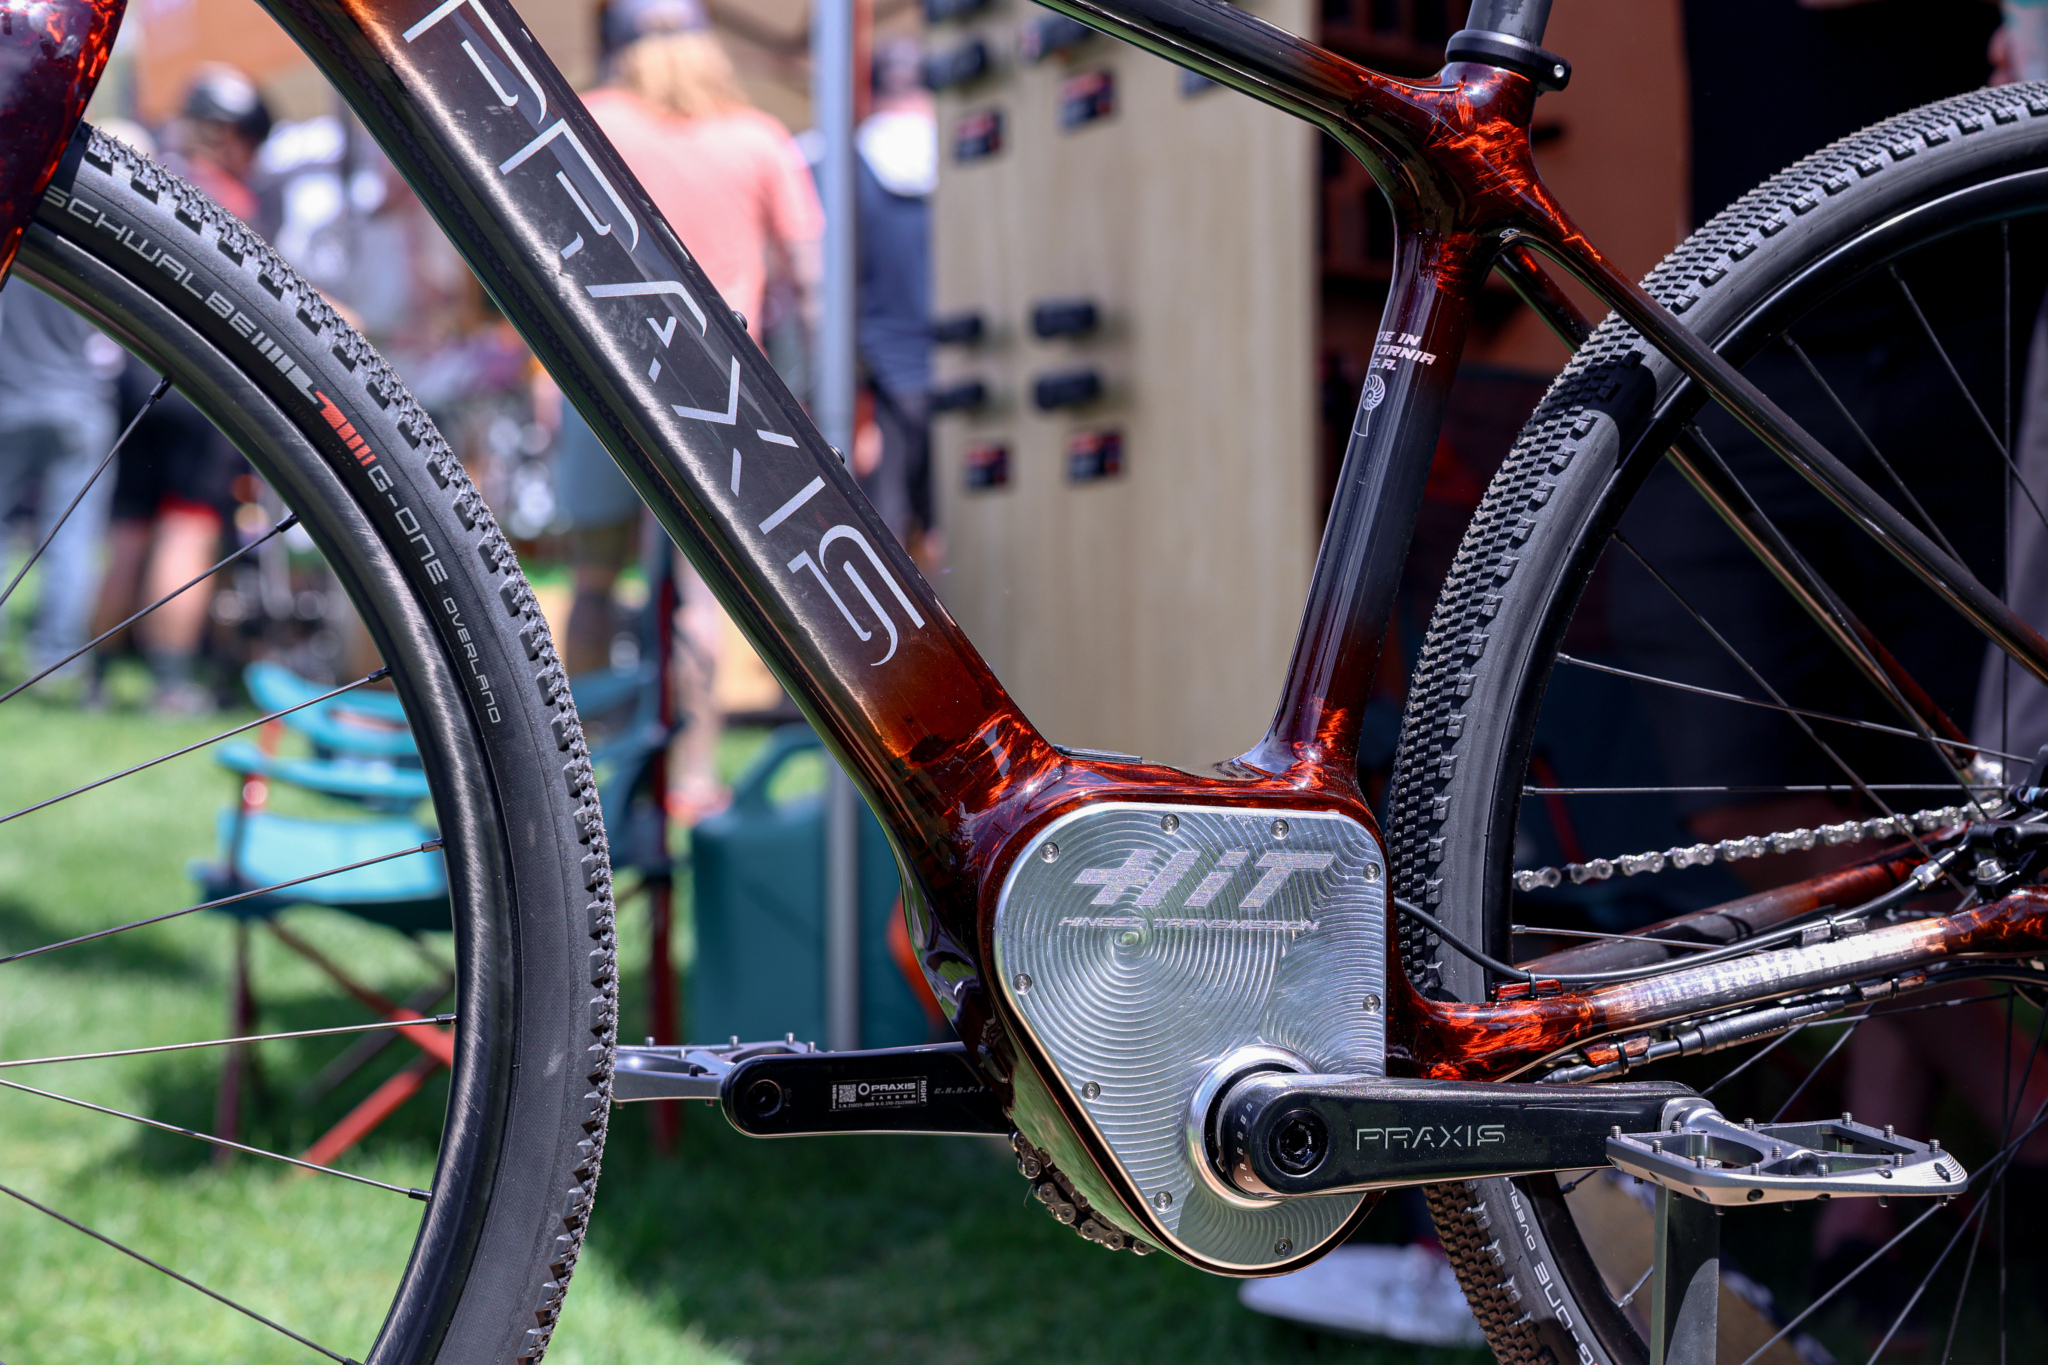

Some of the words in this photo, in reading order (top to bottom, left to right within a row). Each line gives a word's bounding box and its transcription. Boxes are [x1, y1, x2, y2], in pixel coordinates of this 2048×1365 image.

[43, 184, 258, 339] SCHWALBE
[402, 0, 926, 667] PRAXIS
[1397, 332, 1422, 346] IN
[1370, 357, 1397, 370] S.A.
[1374, 344, 1437, 365] FORNIA
[367, 464, 449, 585] G-ONE
[442, 597, 502, 724] OVERLAND
[1058, 916, 1147, 929] HINGED
[1153, 917, 1321, 932] TRANSMISSION
[871, 1083, 916, 1091] PRAXIS
[920, 1080, 928, 1103] RIGHT
[1356, 1123, 1506, 1151] PRAXIS
[1506, 1178, 1537, 1251] OVERL
[1533, 1260, 1595, 1365] G-ONE
